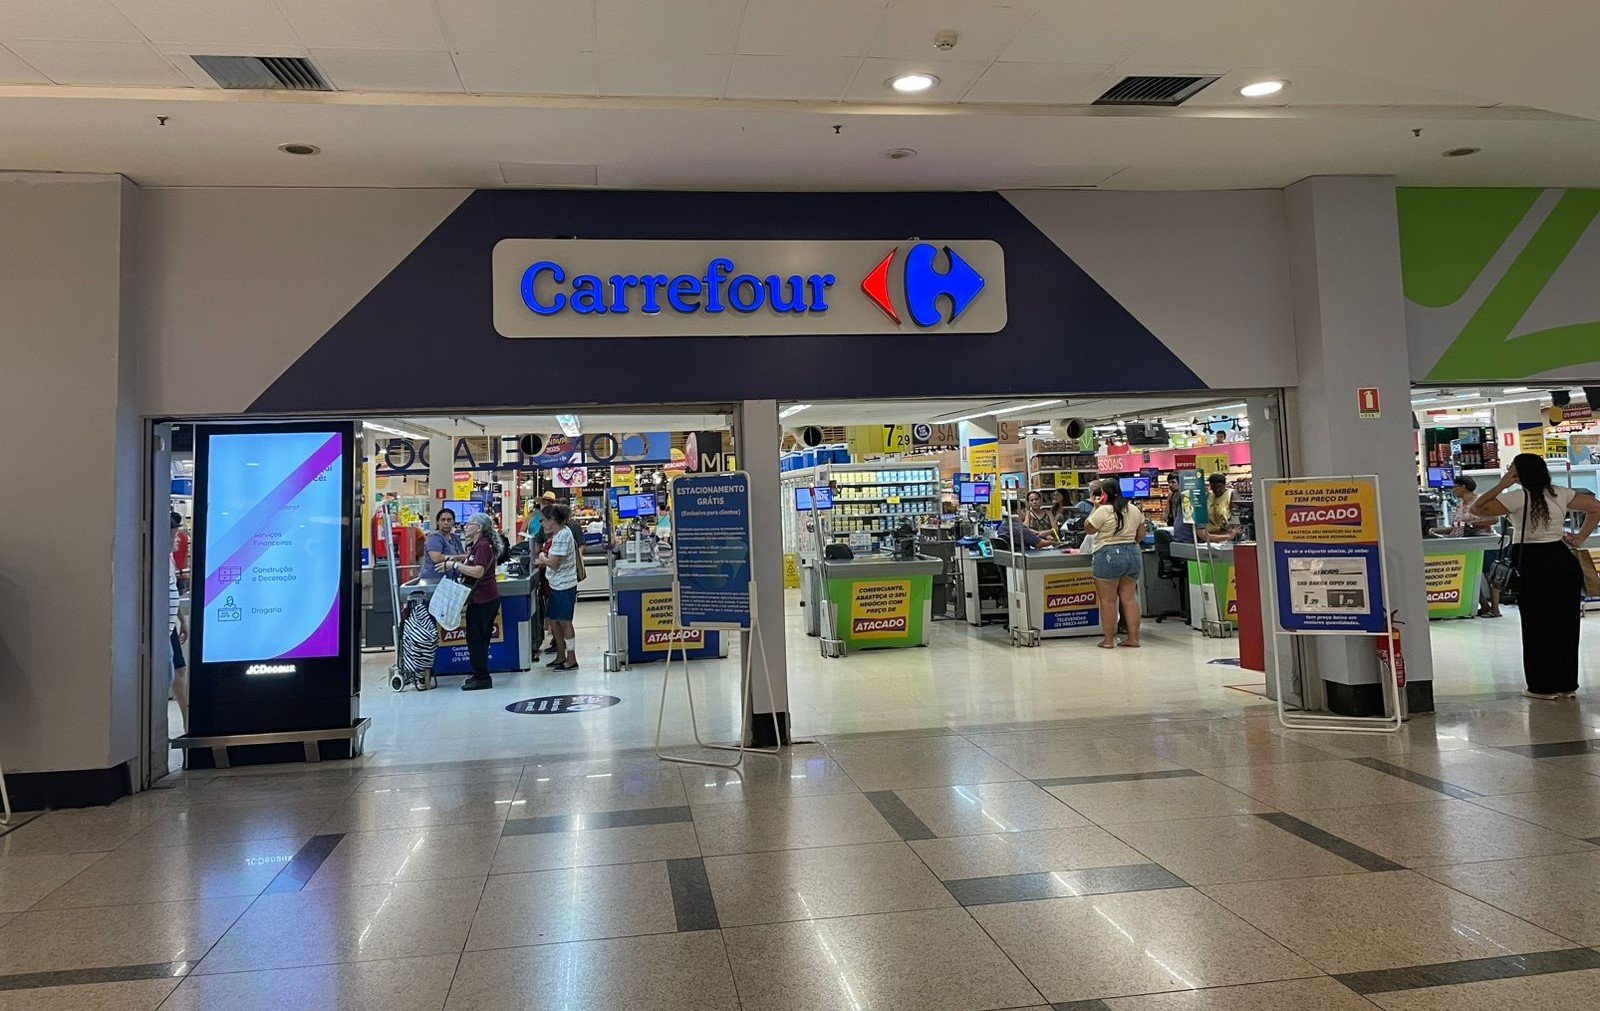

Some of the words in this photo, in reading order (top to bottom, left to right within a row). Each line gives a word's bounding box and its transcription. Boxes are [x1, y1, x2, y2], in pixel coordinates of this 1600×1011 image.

[520, 257, 836, 315] Carrefour
[883, 423, 896, 447] 7
[897, 434, 911, 446] 29
[676, 485, 745, 496] ESTACIONAMENTO
[1305, 488, 1324, 496] LOJA
[1326, 486, 1359, 495] TAMBÉM
[697, 496, 725, 506] GRÁTIS
[1310, 495, 1337, 503] PREÇO
[1289, 507, 1359, 524] ATACADO
[252, 566, 293, 575] Construção
[258, 574, 297, 583] Decoração
[858, 585, 905, 594] COMERCIANTE,
[855, 593, 888, 602] ABASTEÇA
[894, 592, 907, 600] SEU
[1049, 593, 1095, 607] ATACADO
[859, 600, 888, 608] NEGÓCIO
[251, 607, 282, 615] Drogaria
[855, 618, 905, 632] ATACADO
[647, 629, 700, 643] ATACADO
[245, 664, 296, 675] JCDecaux
